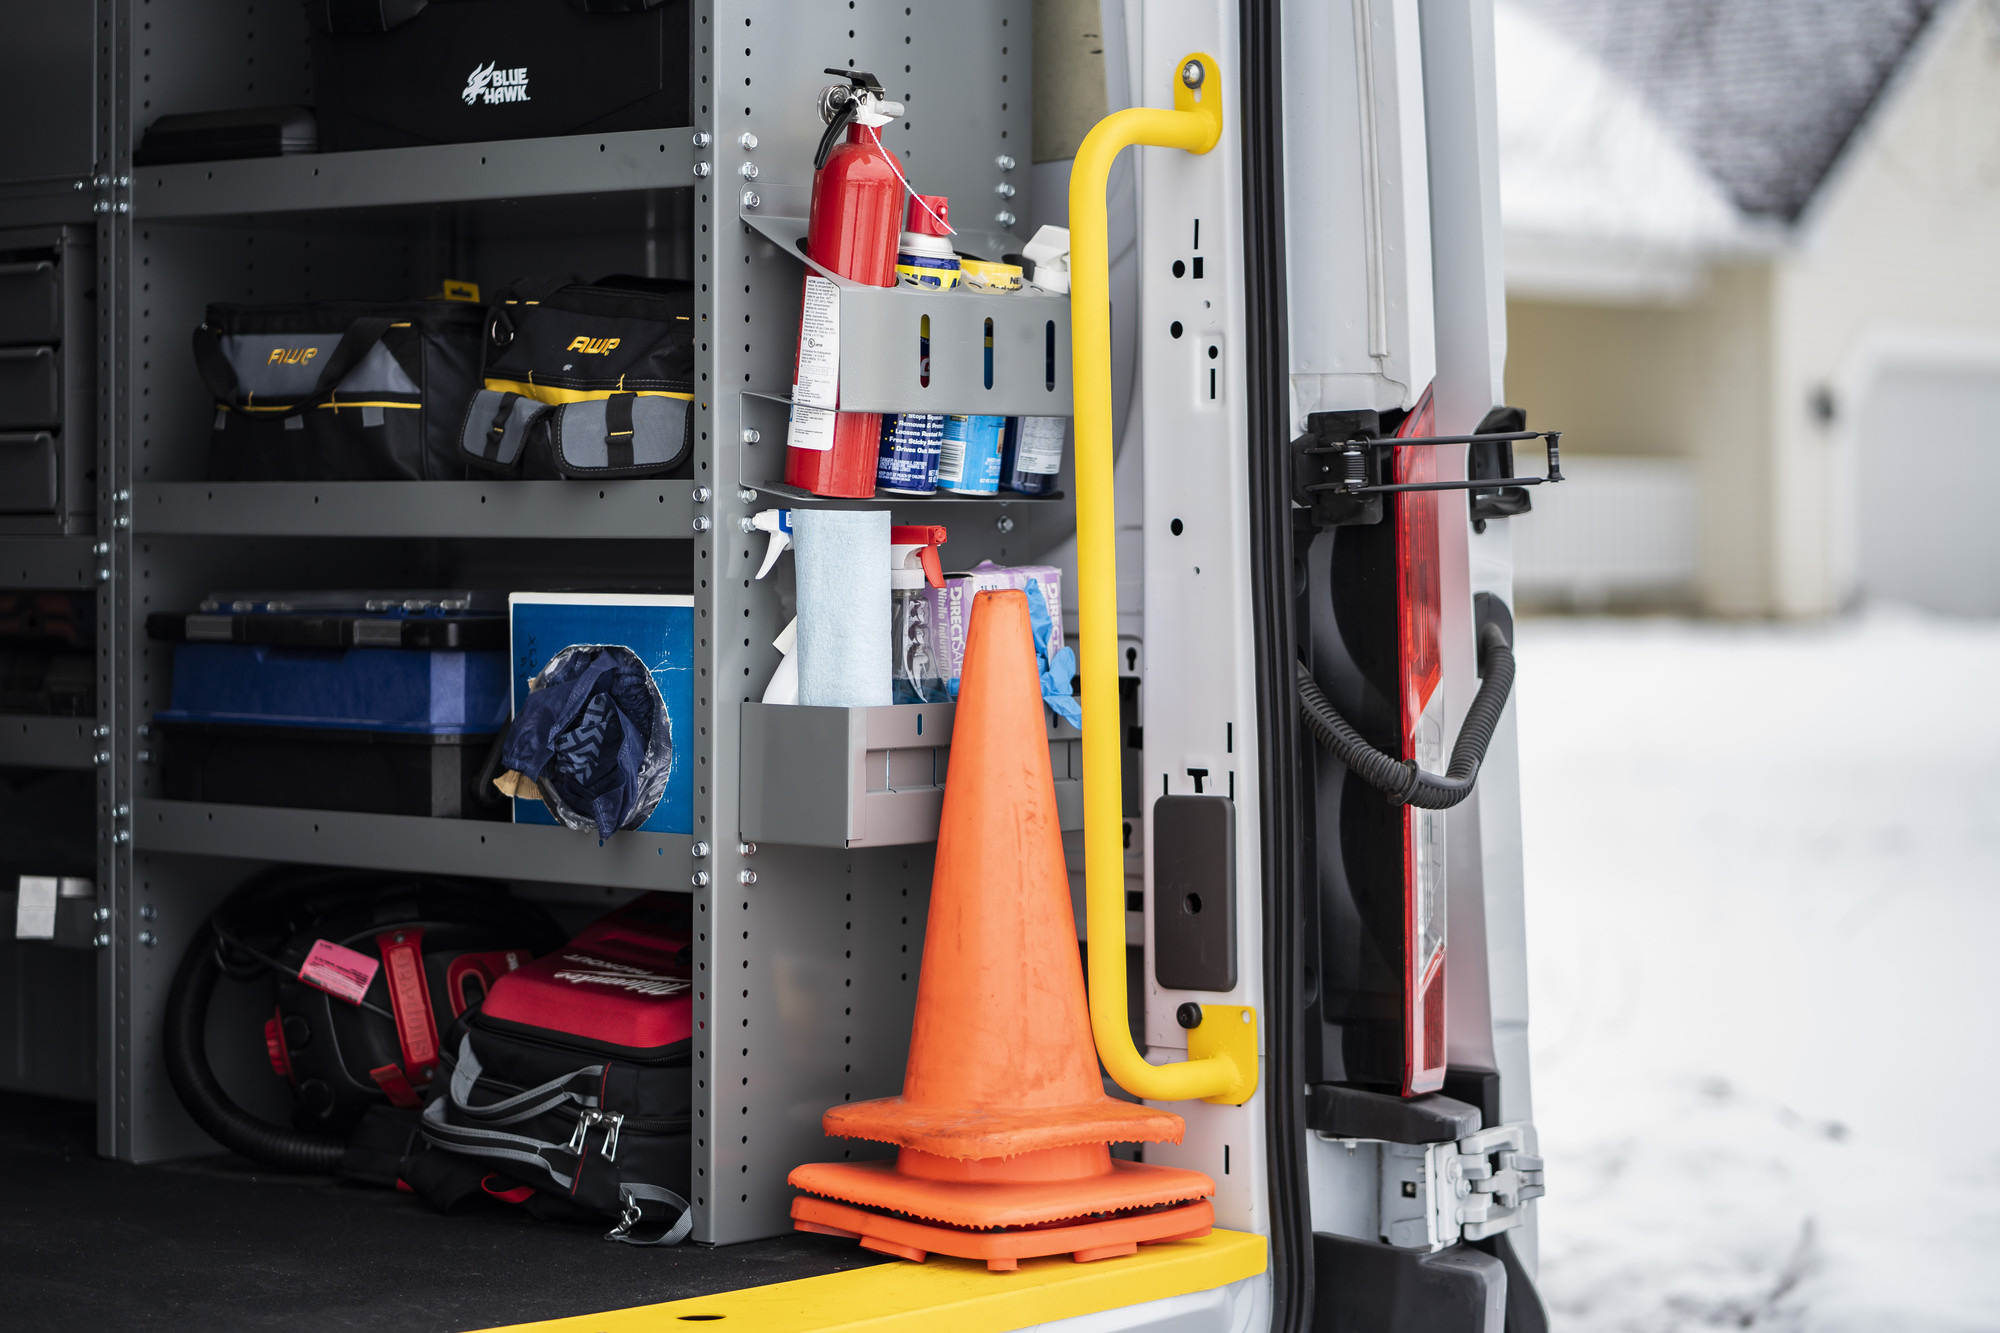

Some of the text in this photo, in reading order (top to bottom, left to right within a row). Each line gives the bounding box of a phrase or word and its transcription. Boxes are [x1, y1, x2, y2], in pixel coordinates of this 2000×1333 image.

[492, 67, 529, 87] BLUE
[483, 84, 529, 105] HAWK
[567, 335, 621, 356] AWP
[266, 347, 318, 366] AWP
[895, 428, 920, 436] Loosens
[898, 420, 926, 428] Removes
[889, 435, 907, 443] Frees
[908, 438, 927, 446] Sticky
[896, 445, 916, 453] Drives
[938, 587, 948, 620] Nitrile
[1047, 582, 1060, 646] DIRECT
[938, 622, 949, 670] Industrial
